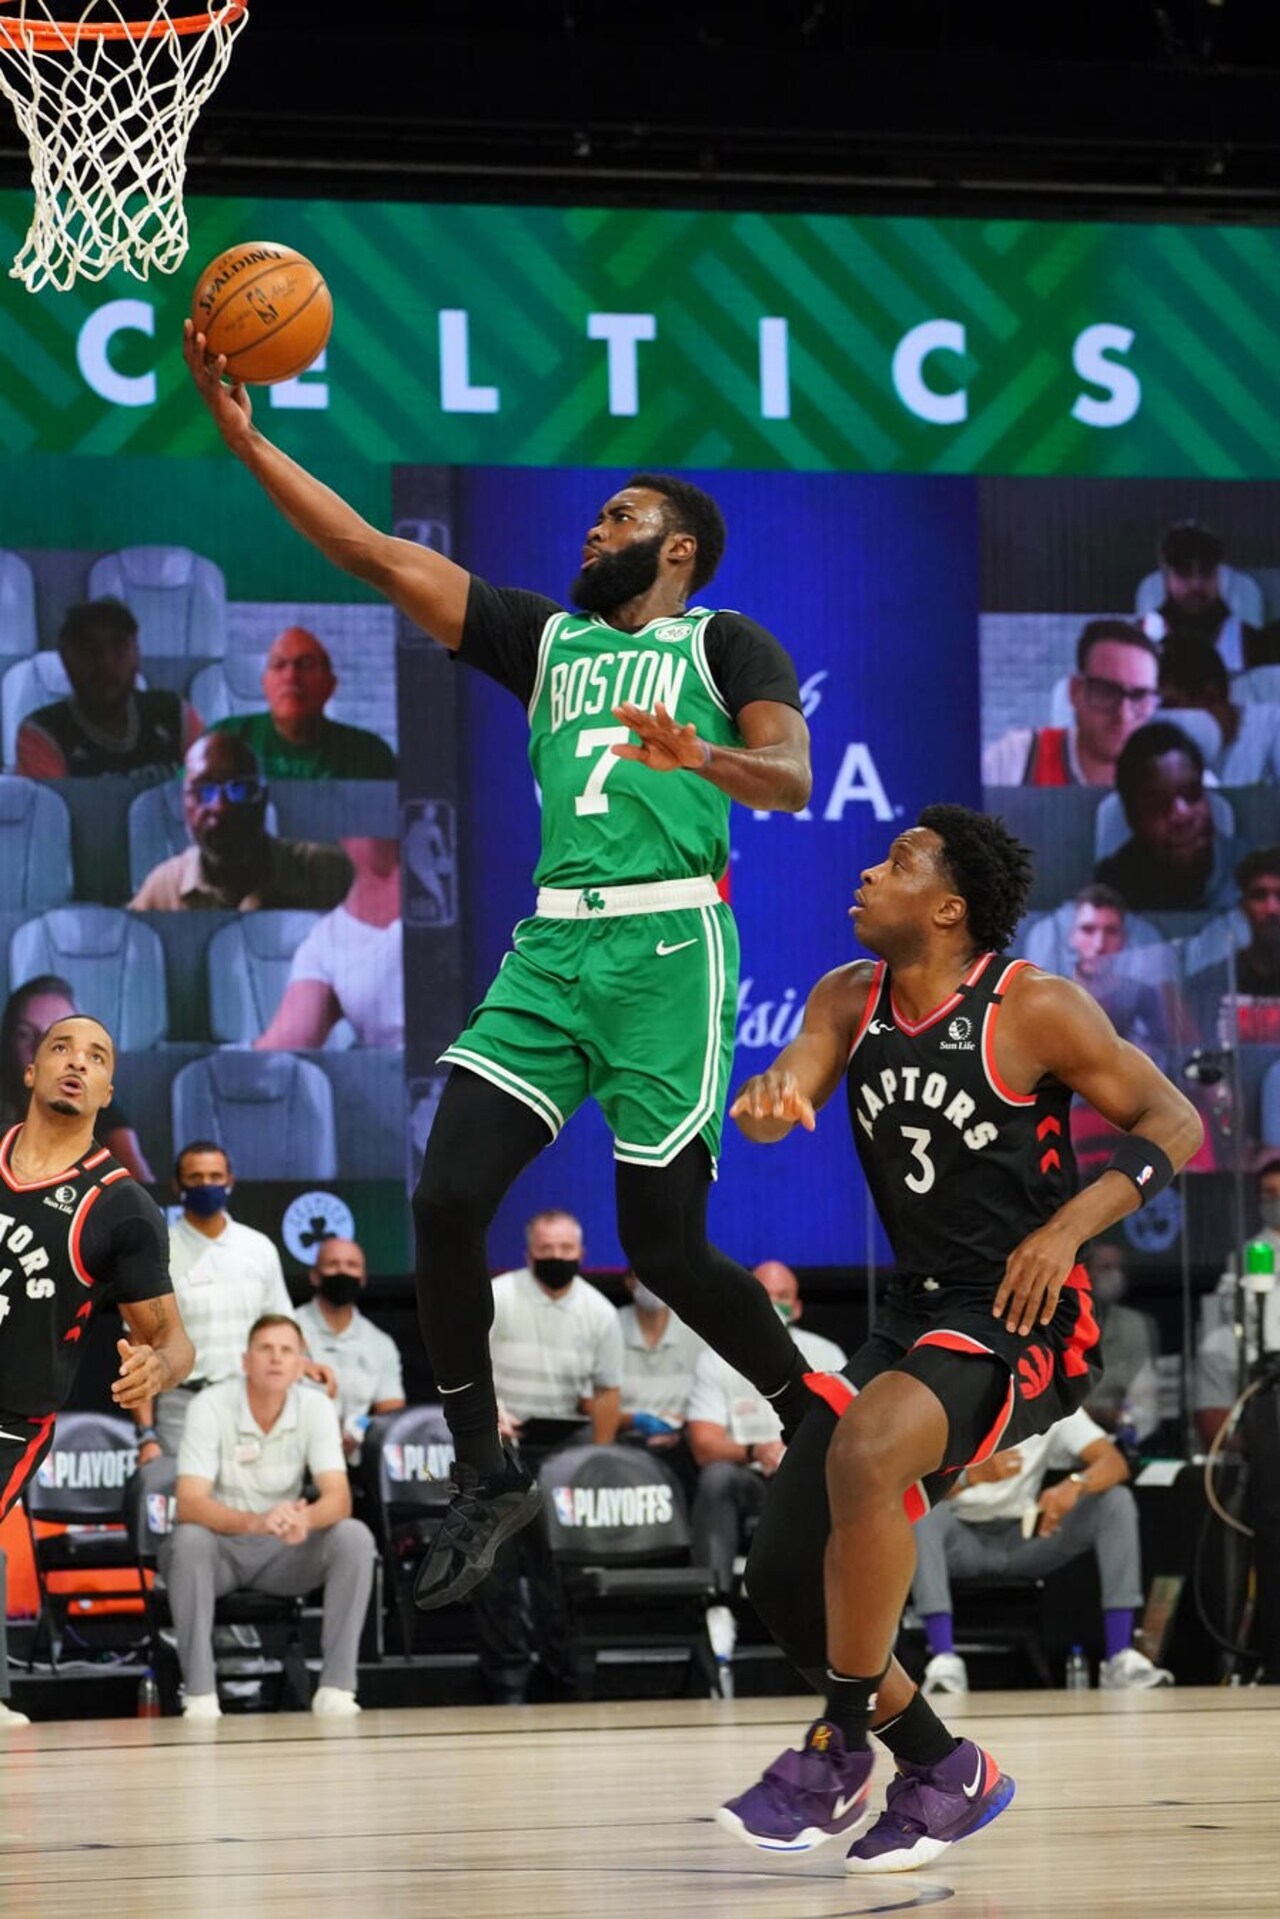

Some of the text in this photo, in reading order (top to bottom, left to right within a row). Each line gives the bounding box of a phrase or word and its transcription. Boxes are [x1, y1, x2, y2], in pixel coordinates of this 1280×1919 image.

[549, 650, 688, 734] BOSTON
[574, 726, 630, 816] 7
[939, 1041, 976, 1051] Sun Life
[900, 1125, 936, 1194] 3
[572, 1484, 674, 1527] PLAYOFFS
